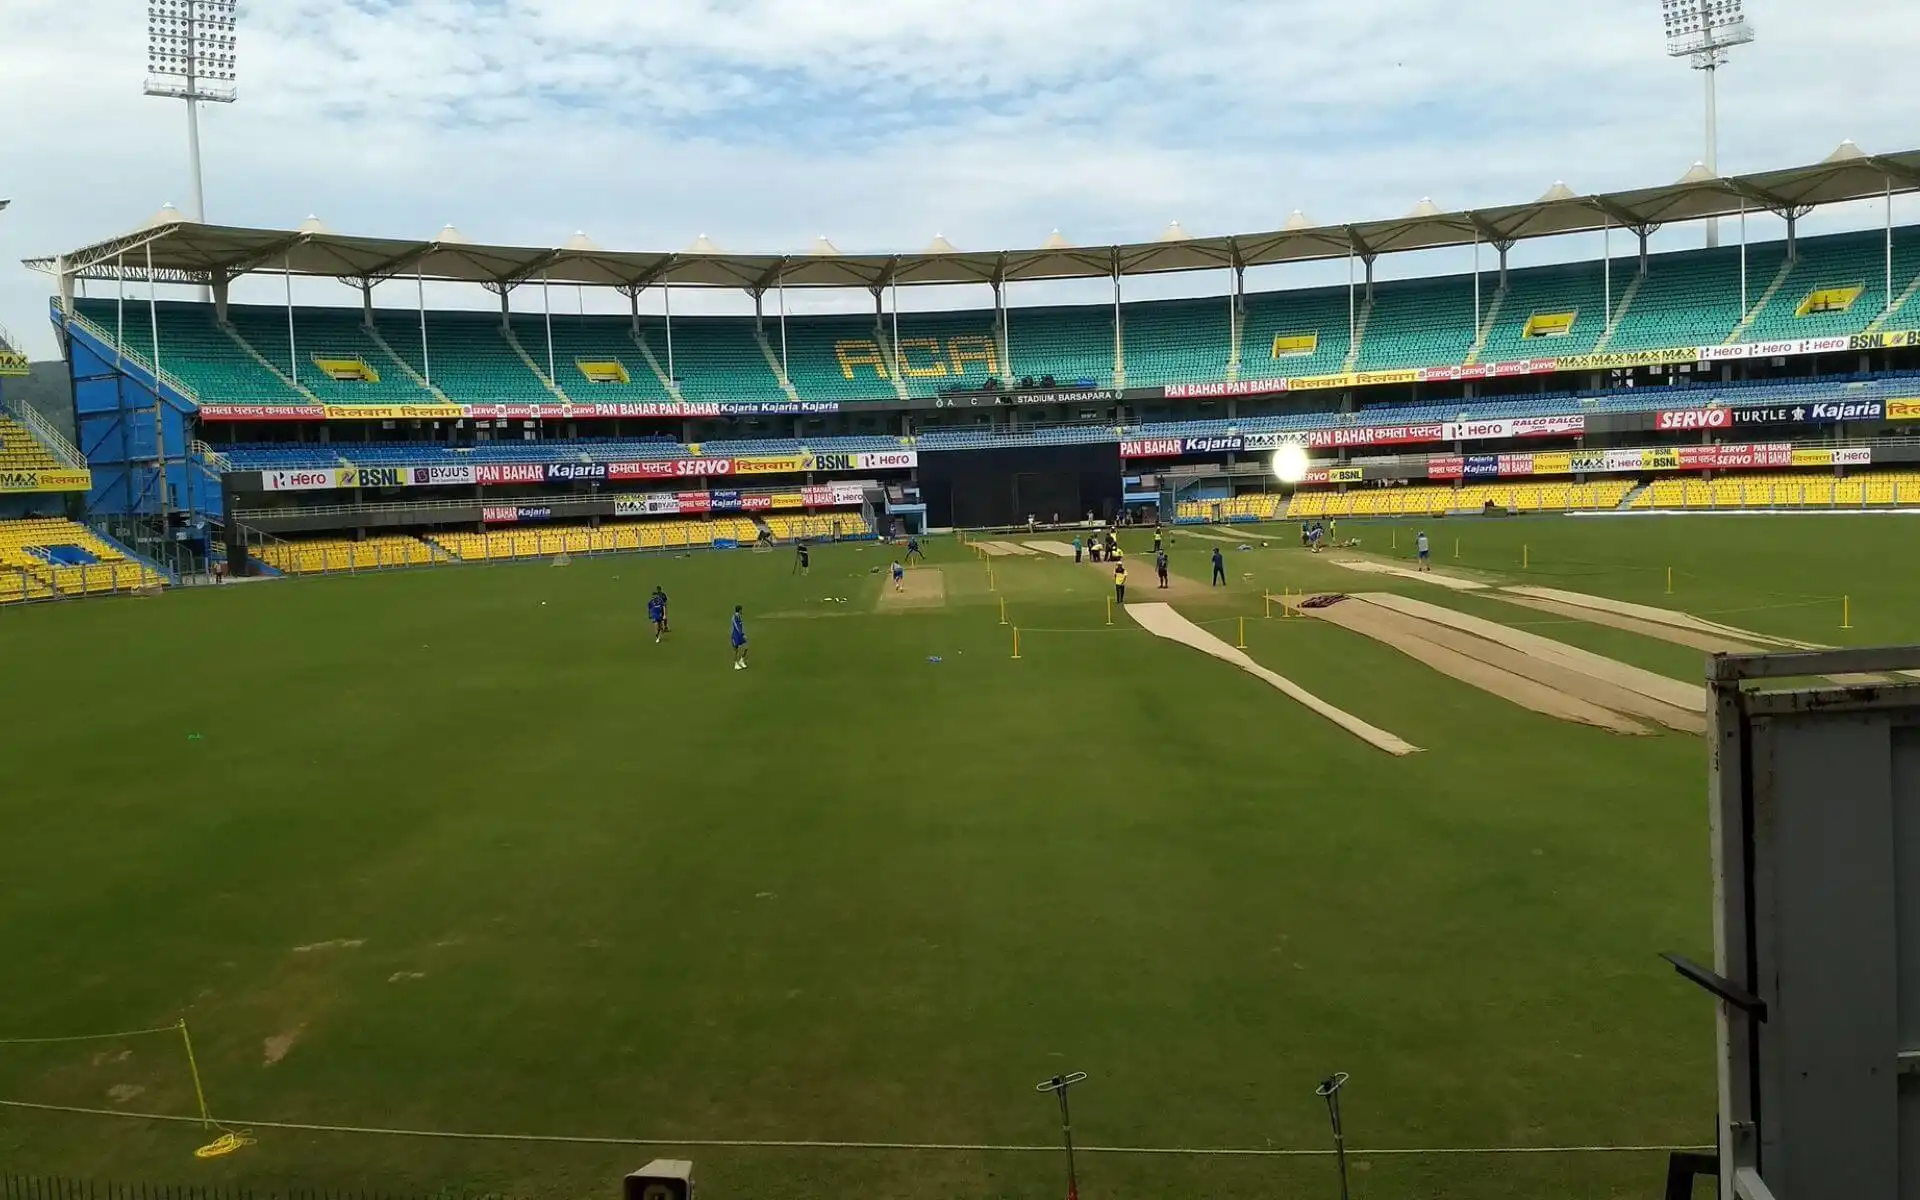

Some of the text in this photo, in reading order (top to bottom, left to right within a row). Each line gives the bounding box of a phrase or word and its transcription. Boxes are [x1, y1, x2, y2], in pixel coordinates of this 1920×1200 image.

[1849, 334, 1888, 349] BSNL
[835, 336, 997, 380] ACA
[1557, 348, 1696, 367] MAX MAX MAX MAX
[1461, 367, 1485, 375] SERVO
[1495, 365, 1520, 373] SERVO
[1530, 361, 1556, 370] SERVO
[1164, 378, 1288, 398] PAN BAHAR PAN BAHAR
[1058, 392, 1112, 402] BARSAPARA
[595, 402, 720, 416] PAN BAHAR PAN BAHAR
[720, 401, 839, 414] Kajaria Kajaria Kajaria
[1812, 402, 1881, 420] Kajaria
[1512, 416, 1583, 426] RALCO RALCO
[1661, 411, 1724, 428] SERVO
[1734, 409, 1786, 422] TURTLE
[1310, 429, 1374, 445] PAN BAHAR
[1375, 426, 1442, 439] कमला पसन्द
[1120, 440, 1181, 455] PAN BAHAR
[1186, 437, 1242, 452] Kajaria
[1768, 443, 1791, 451] BAHAR
[816, 455, 853, 469] BSNL
[1653, 457, 1677, 467] BSNL
[1717, 455, 1751, 465] SERVO
[1754, 451, 1791, 464] PAN BAHAR
[431, 467, 469, 478] BYJU'S
[476, 465, 543, 480] PAN BAHAR
[548, 463, 605, 479] Kajaria
[609, 460, 673, 474] कमला पसन्द
[677, 460, 730, 476] SERVO
[1464, 465, 1498, 474] Kajaria
[359, 469, 404, 486] BSNL
[1339, 471, 1361, 480] BSNL
[711, 499, 741, 508] Kajaria
[742, 498, 770, 506] SERVO
[483, 507, 517, 520] PAN BAHAR
[518, 507, 551, 517] Kajaria
